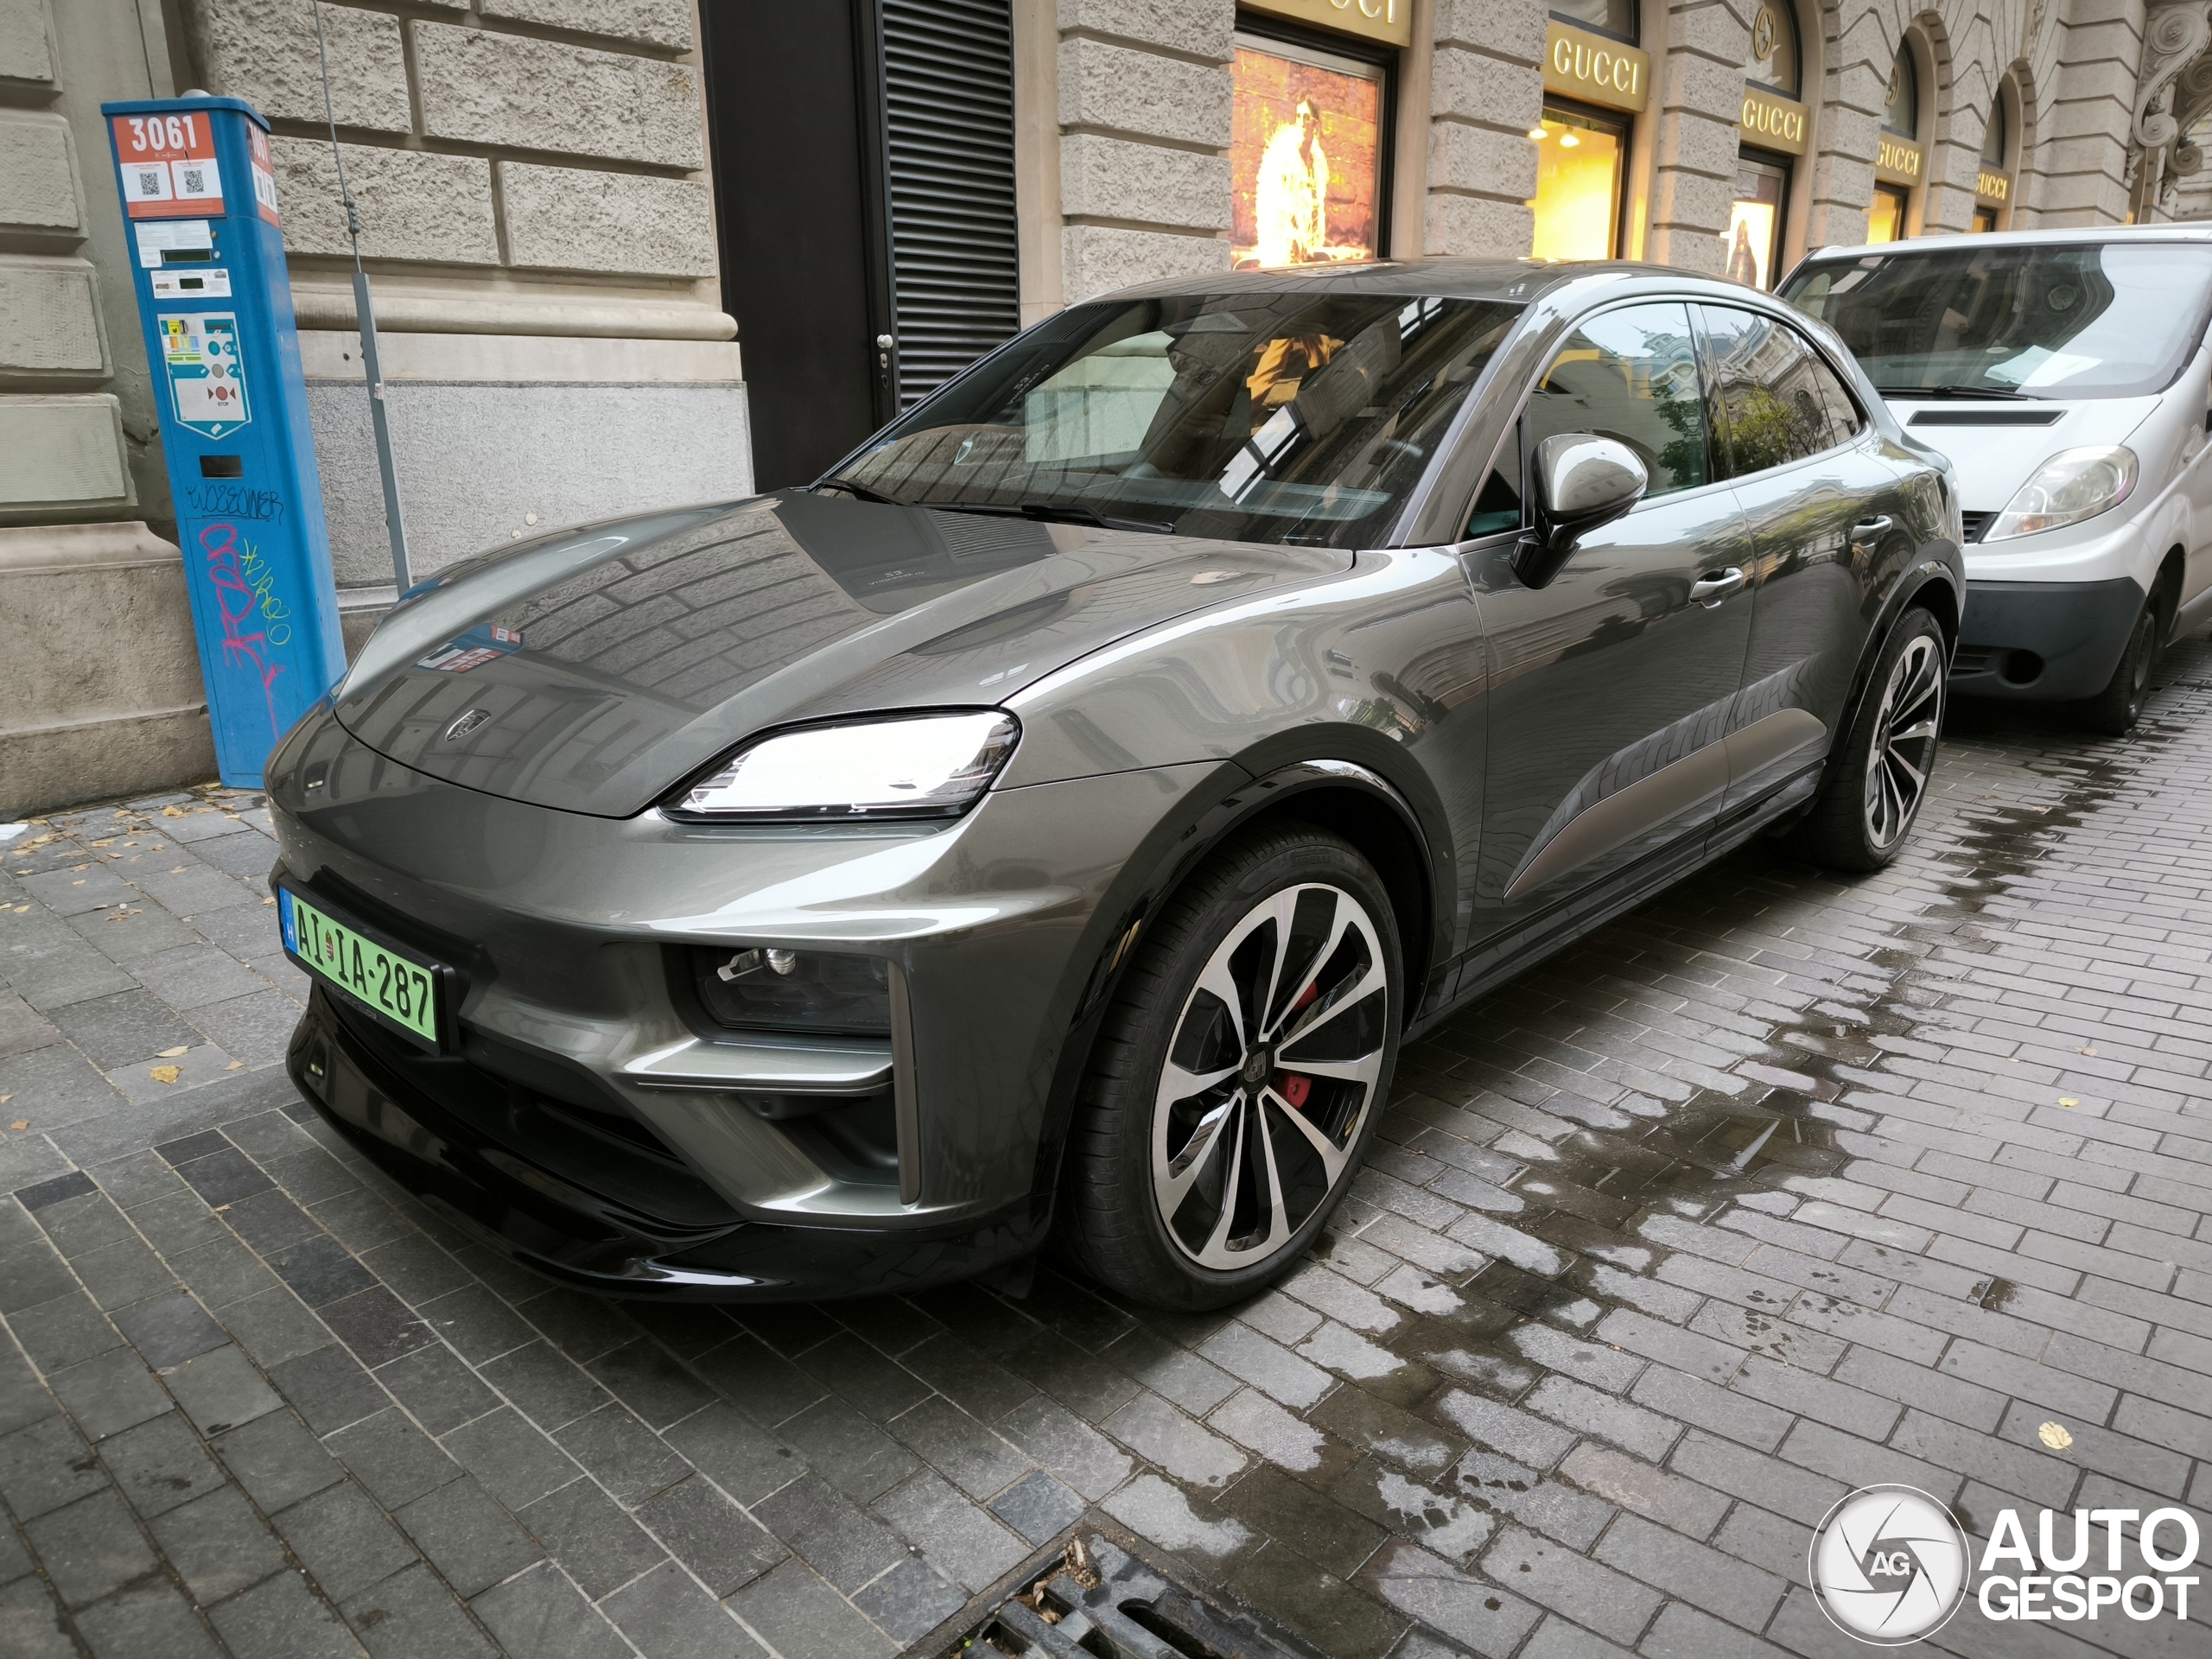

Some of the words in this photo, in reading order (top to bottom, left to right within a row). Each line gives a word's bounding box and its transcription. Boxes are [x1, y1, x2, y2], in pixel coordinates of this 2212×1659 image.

[1554, 37, 1639, 94] GUCCI
[129, 115, 198, 152] 3061
[1743, 99, 1803, 143] GUCCI
[286, 922, 295, 942] H
